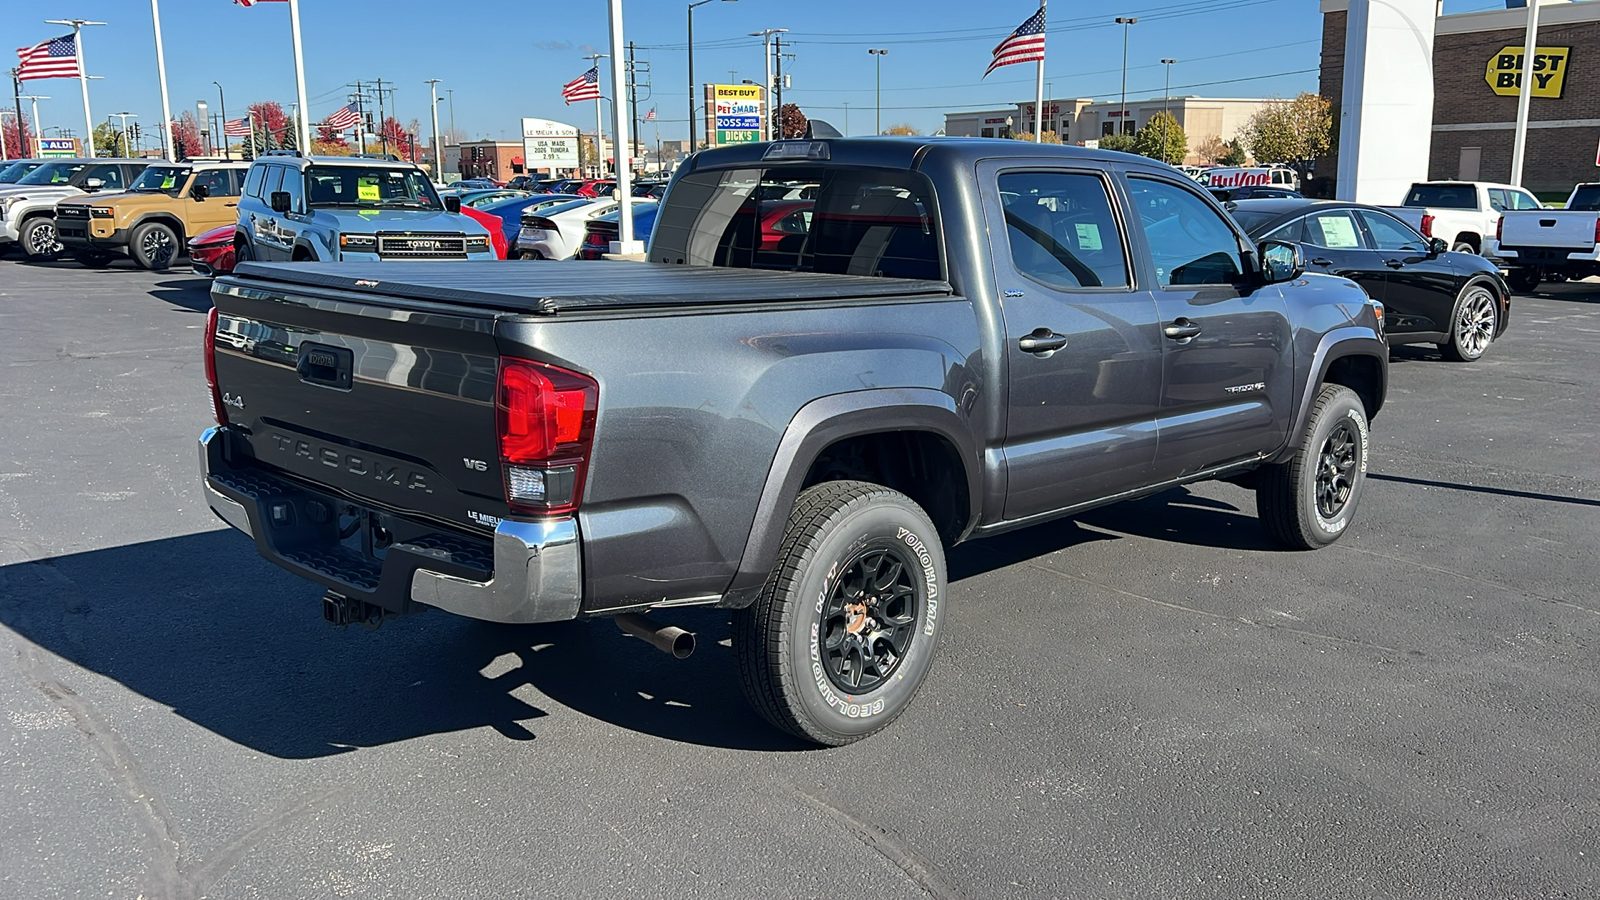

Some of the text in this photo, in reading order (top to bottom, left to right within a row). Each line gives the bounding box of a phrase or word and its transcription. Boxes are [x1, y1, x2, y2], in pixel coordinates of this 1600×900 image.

[717, 118, 742, 127] ROSS
[725, 130, 753, 141] DICK'S
[50, 141, 73, 149] ALDI
[407, 240, 441, 248] TOYOTA
[308, 352, 335, 367] TOYOTA
[271, 432, 434, 494] TACOMA
[463, 457, 489, 472] V6
[467, 510, 501, 525] LE MIEU
[896, 526, 939, 637] YOKOHAMA
[809, 622, 885, 719] GEOLANDAR
